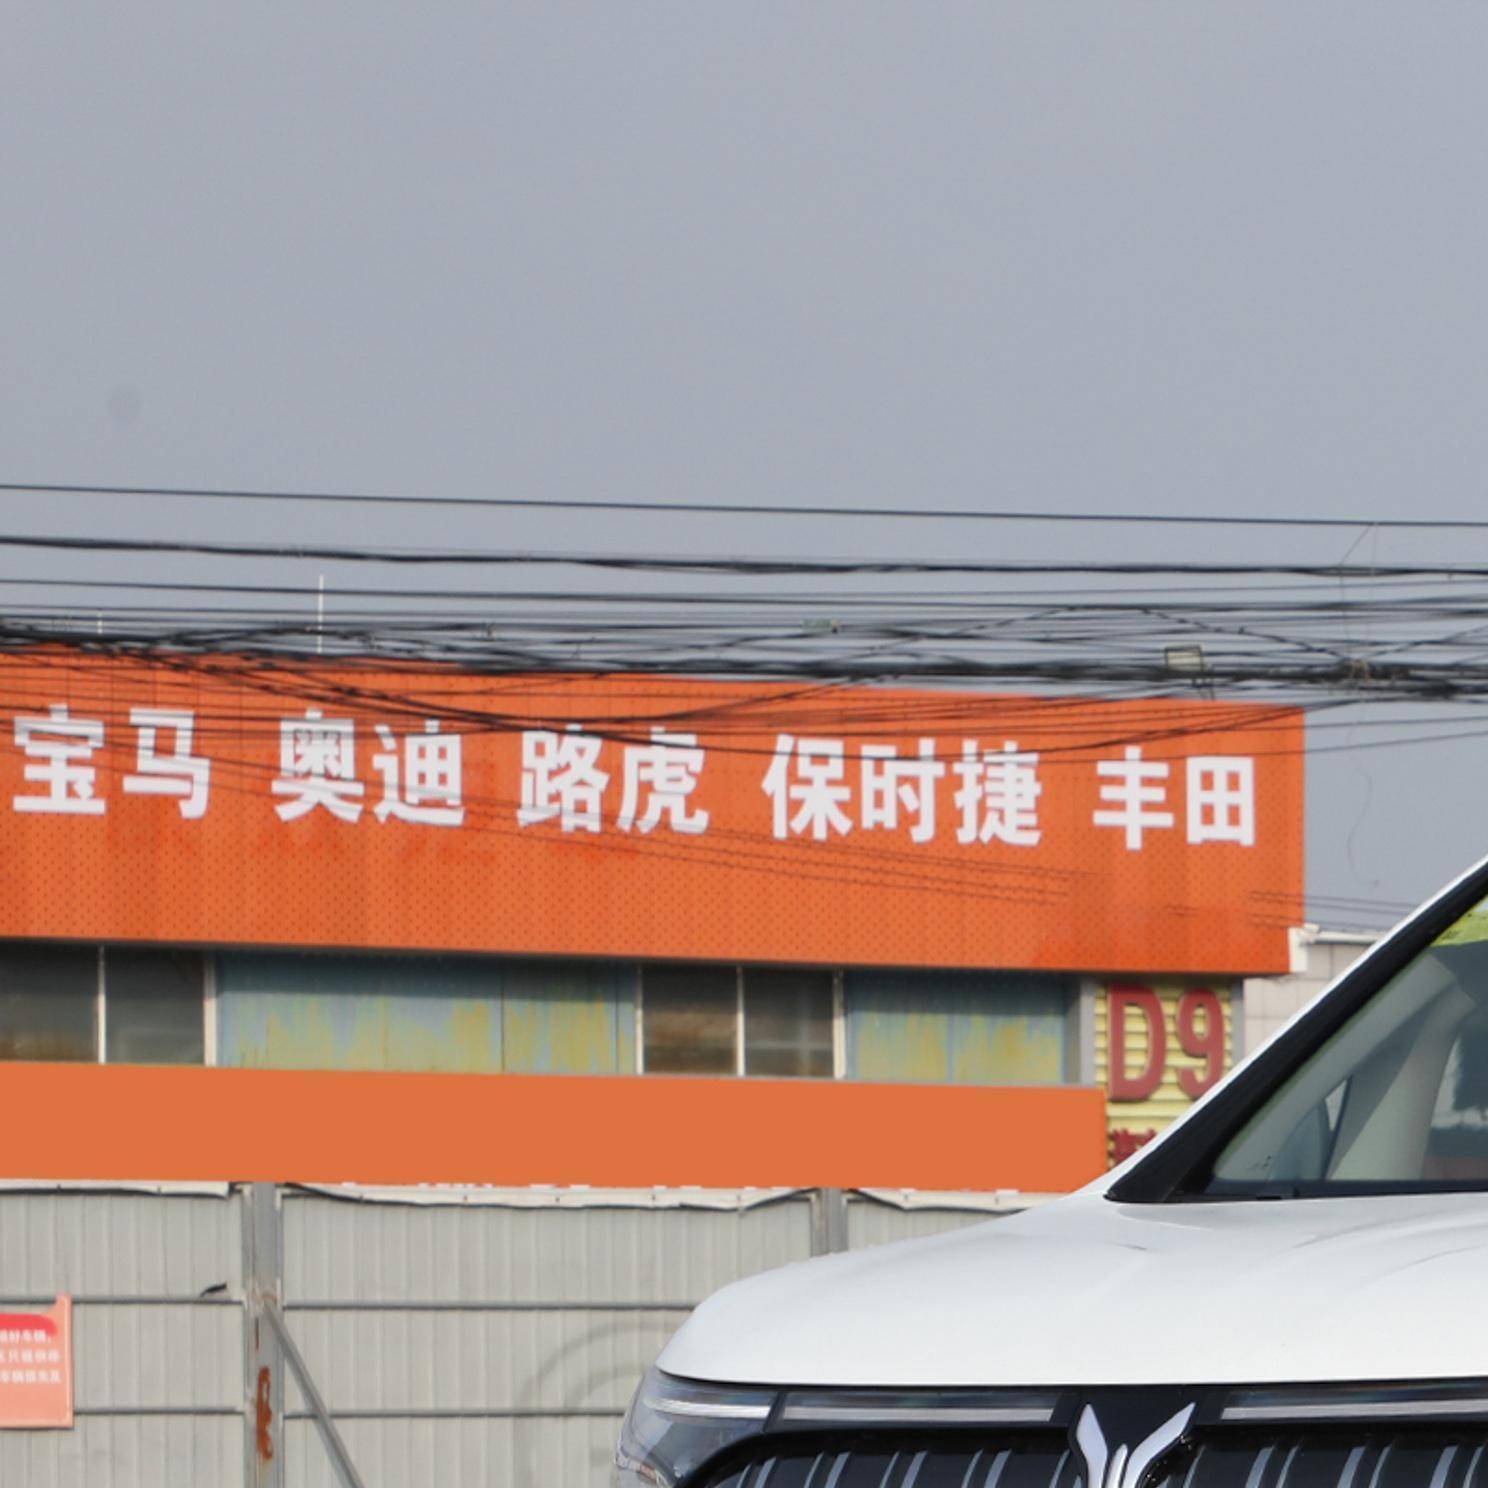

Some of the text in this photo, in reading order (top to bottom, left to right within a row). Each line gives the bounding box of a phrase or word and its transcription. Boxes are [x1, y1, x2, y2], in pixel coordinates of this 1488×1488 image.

[13, 704, 1256, 851] 宝马 奥迪 路虎 保时捷 丰田
[1109, 983, 1225, 1101] D9
